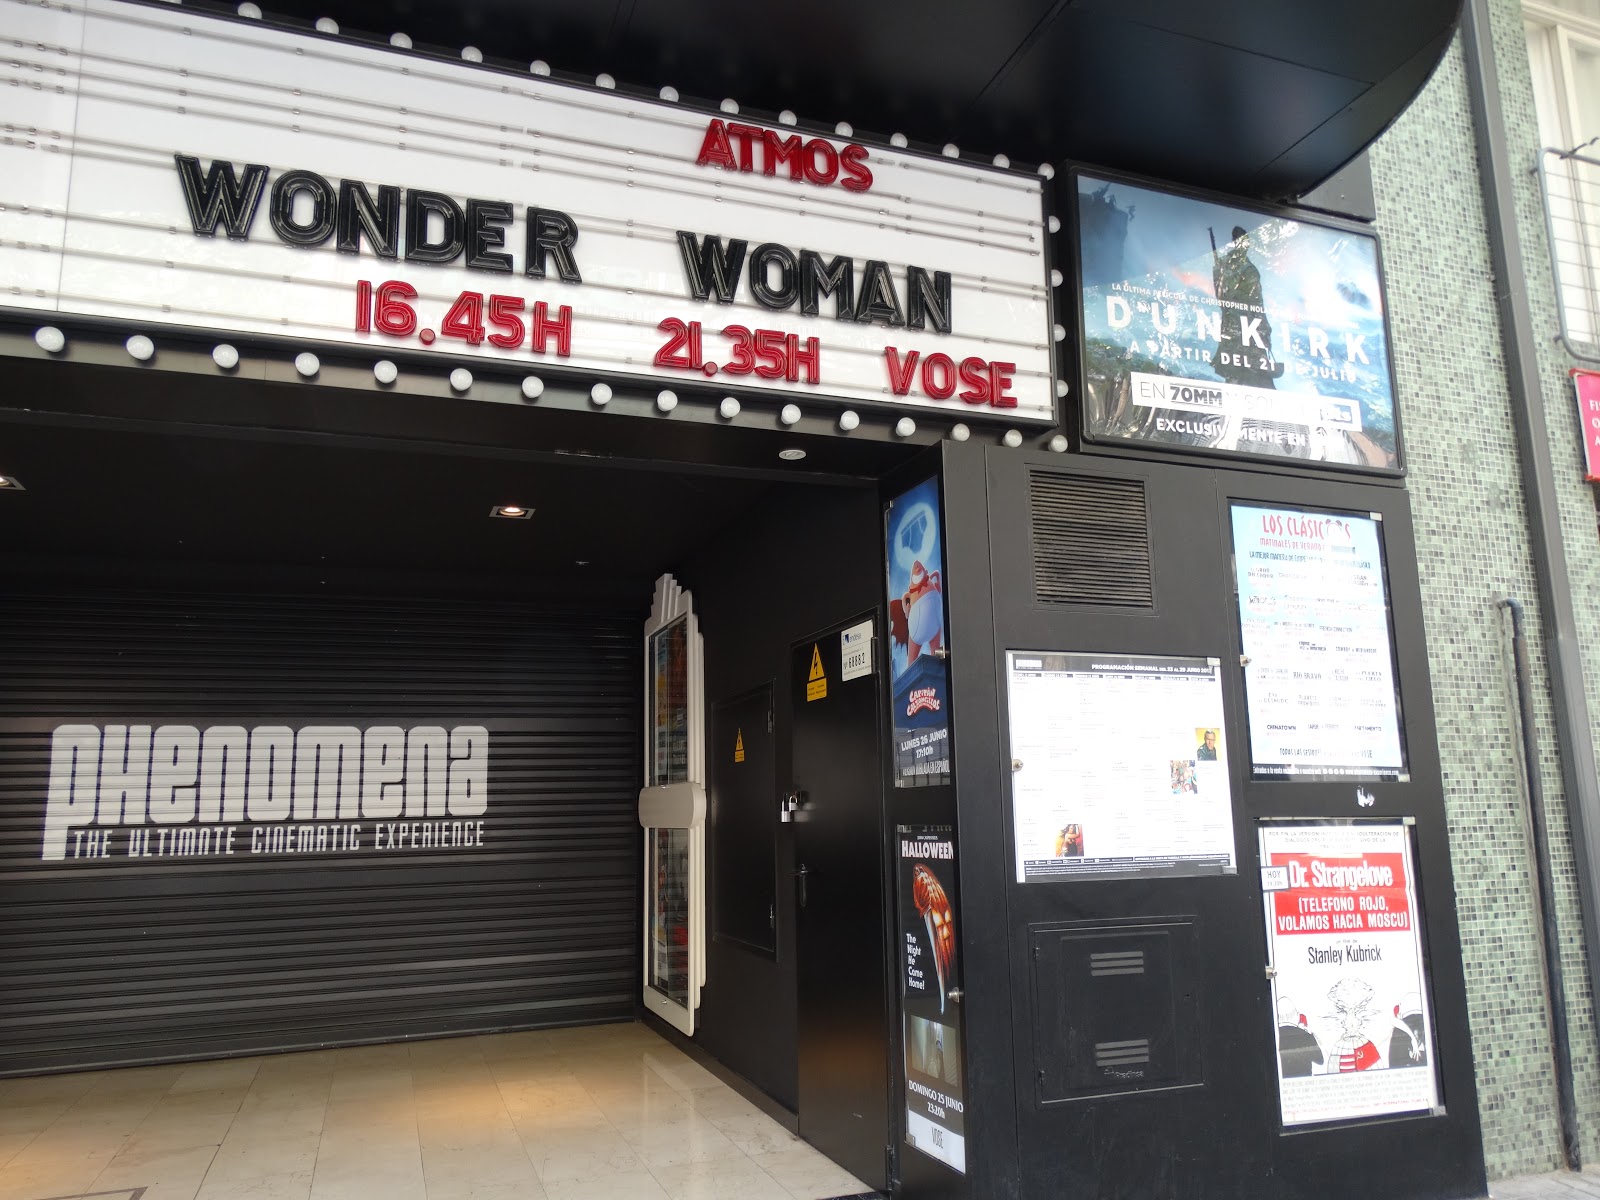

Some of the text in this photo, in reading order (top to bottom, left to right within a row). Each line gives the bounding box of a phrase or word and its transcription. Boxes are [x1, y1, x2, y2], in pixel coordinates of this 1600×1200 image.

[695, 118, 874, 193] ATMOS
[174, 154, 952, 334] WONDER WOMAN
[1112, 283, 1121, 291] LA
[1200, 297, 1249, 311] CHRISTOPHER
[1106, 295, 1370, 365] DUNKIRK
[354, 279, 1018, 408] 16.45H 21.35H VOSE
[1130, 340, 1140, 354] A
[1146, 341, 1212, 363] PARTIR
[1221, 352, 1251, 368] DEL
[1259, 358, 1275, 372] 21
[1140, 381, 1166, 399] EN
[1170, 385, 1222, 406] 70MM
[1156, 418, 1283, 444] EXCLUSIVMENTE
[1288, 434, 1306, 446] EN
[1262, 514, 1284, 536] LOS
[901, 728, 948, 752] LUNES 26 JUNIO
[74, 821, 485, 859] THE ULTIMATE CINEMATIC EXPERIENCE
[901, 840, 954, 860] HALLOWEEN
[1266, 870, 1281, 879] HOY
[1288, 860, 1393, 891] Dr. Strangelove
[1298, 896, 1389, 913] (TELEFONO ROJO,
[1278, 911, 1408, 931] VOLAMOS HACIA MOSCU)
[905, 933, 917, 944] The
[906, 944, 921, 957] Night
[908, 955, 916, 966] He
[1308, 944, 1382, 966] Stanley Kubrick
[908, 976, 925, 990] Home!
[908, 1079, 964, 1113] DOMINGO 25 JUNIO
